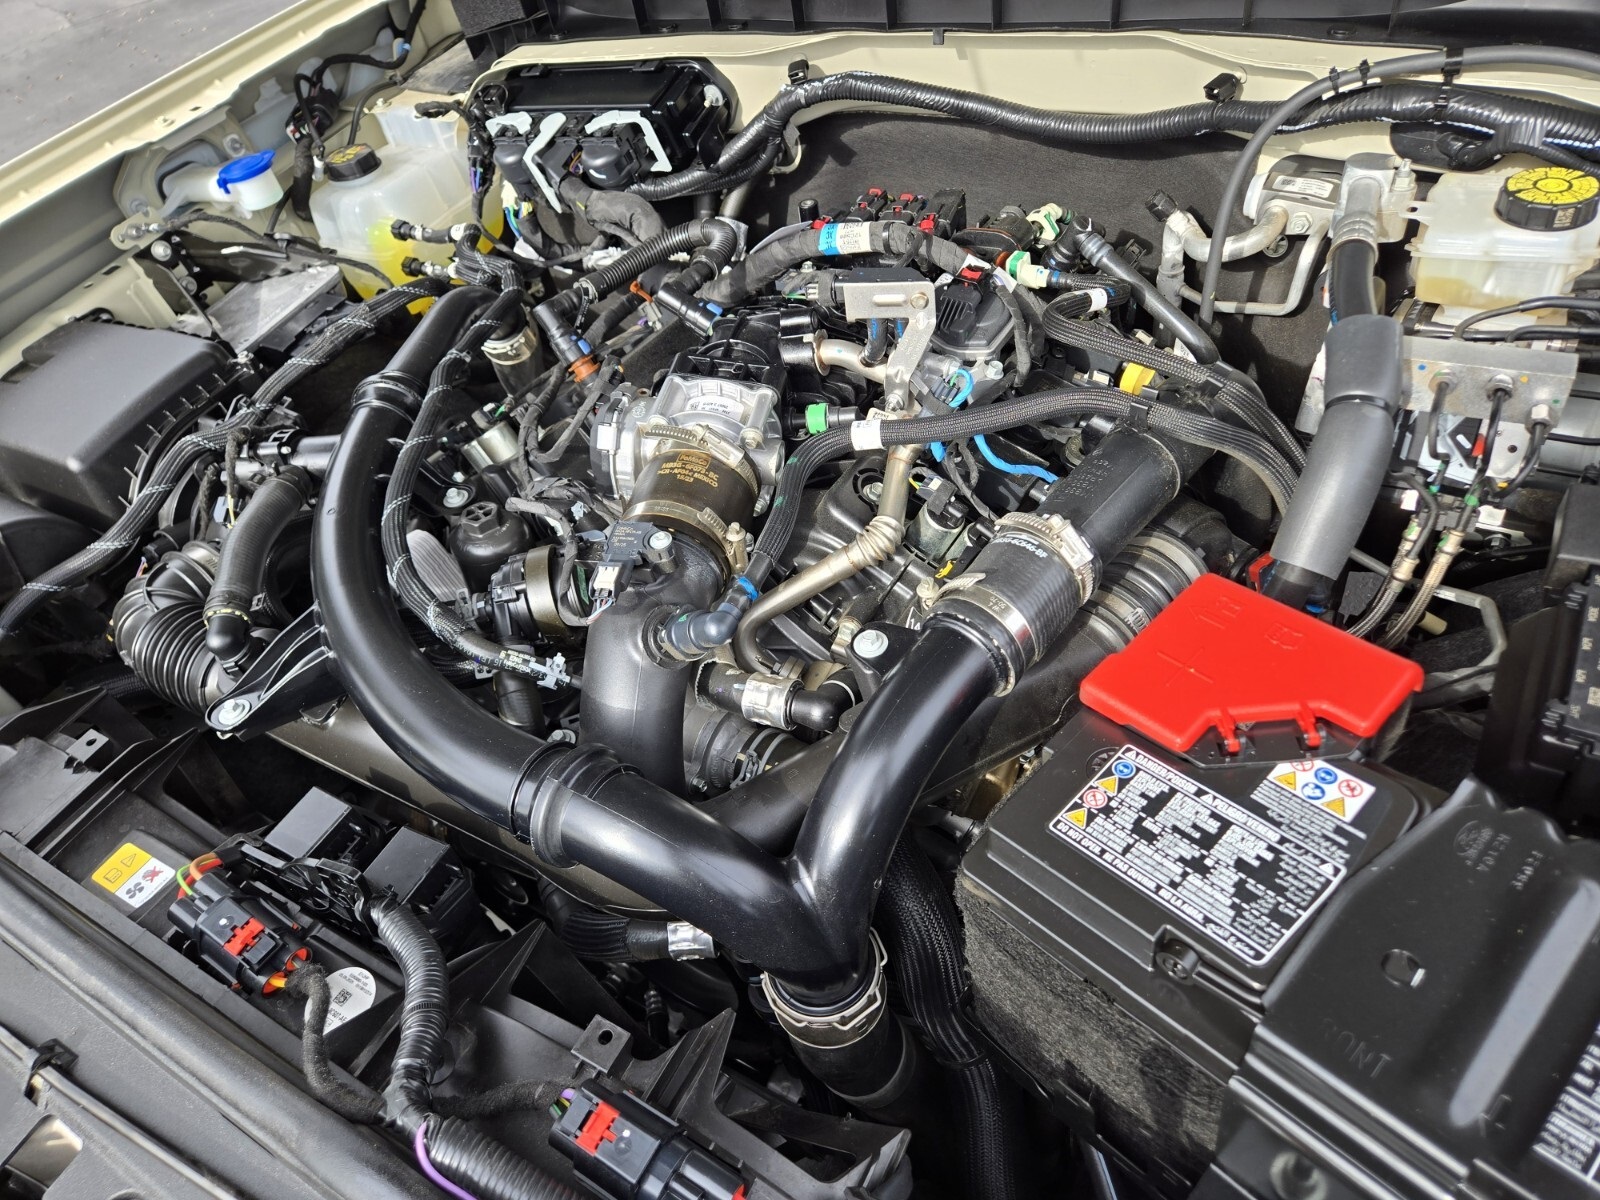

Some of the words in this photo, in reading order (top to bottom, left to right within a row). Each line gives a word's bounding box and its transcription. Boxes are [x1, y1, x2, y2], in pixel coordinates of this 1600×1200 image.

[693, 472, 718, 488] MEXICO
[1134, 753, 1198, 794] DANGER/POISON
[1209, 797, 1281, 843] PELIGRO/VENENO
[1055, 820, 1070, 832] DO
[1065, 827, 1084, 842] NOT
[1079, 836, 1104, 855] OPEN.
[1101, 850, 1116, 863] NE
[1111, 857, 1130, 872] PAS
[1168, 895, 1184, 908] LA
